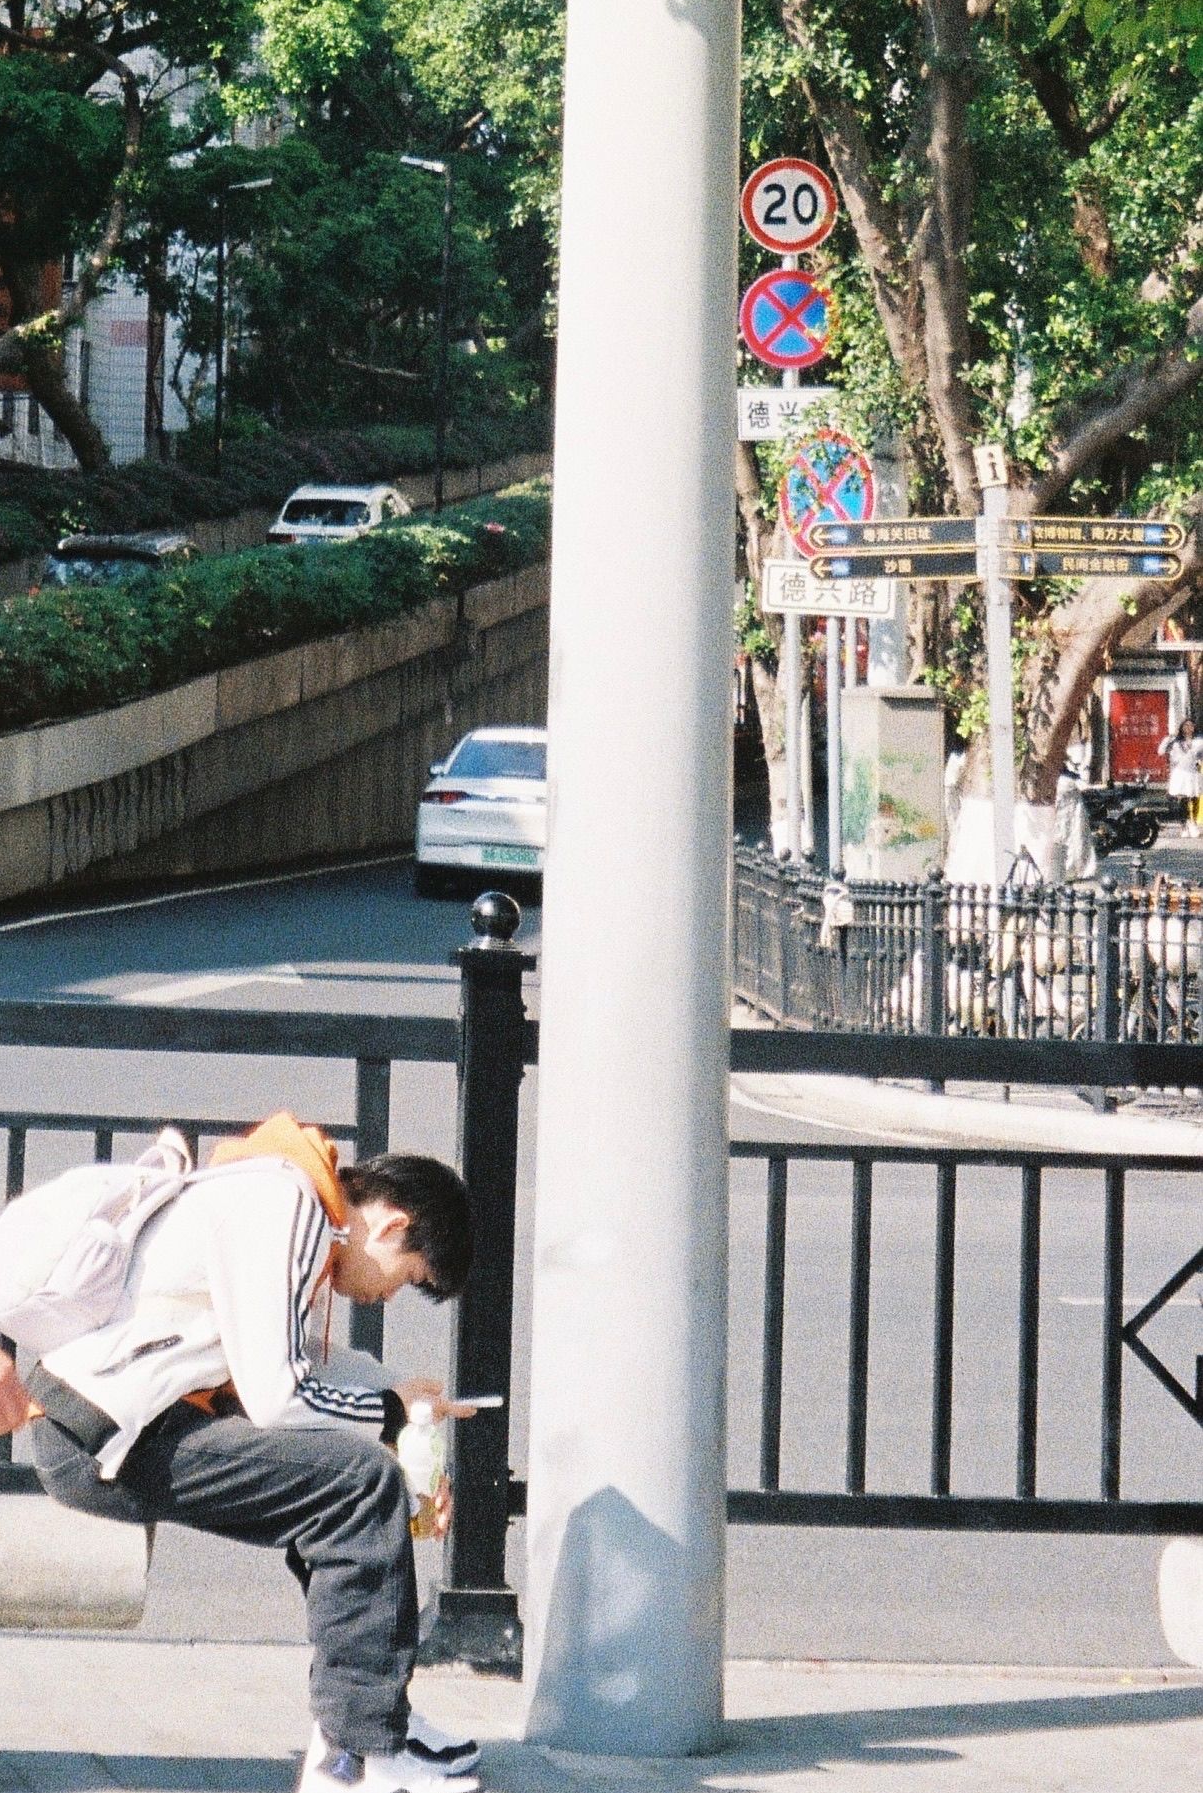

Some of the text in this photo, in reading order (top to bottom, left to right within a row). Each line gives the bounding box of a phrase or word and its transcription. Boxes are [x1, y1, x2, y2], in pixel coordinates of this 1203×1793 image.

[762, 182, 818, 226] 20
[780, 572, 877, 606] 德兴路
